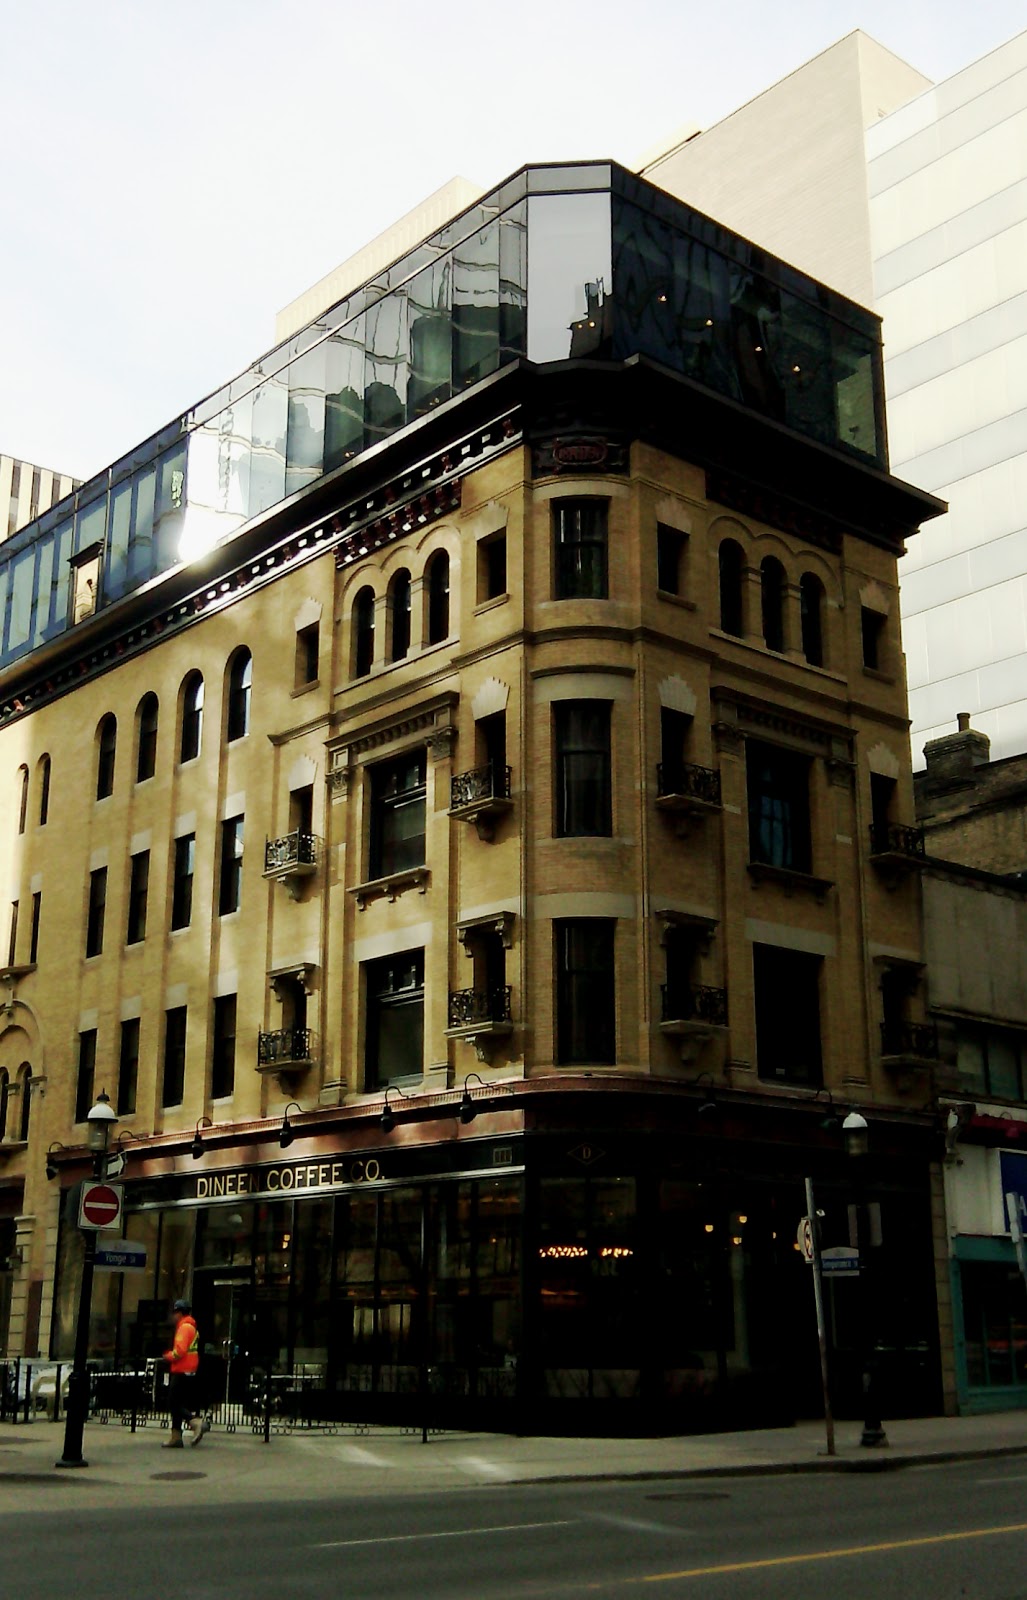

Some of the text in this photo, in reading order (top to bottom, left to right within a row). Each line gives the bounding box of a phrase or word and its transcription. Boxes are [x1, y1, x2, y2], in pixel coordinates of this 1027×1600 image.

[197, 1159, 386, 1198] DINEEN COFFEE CO.
